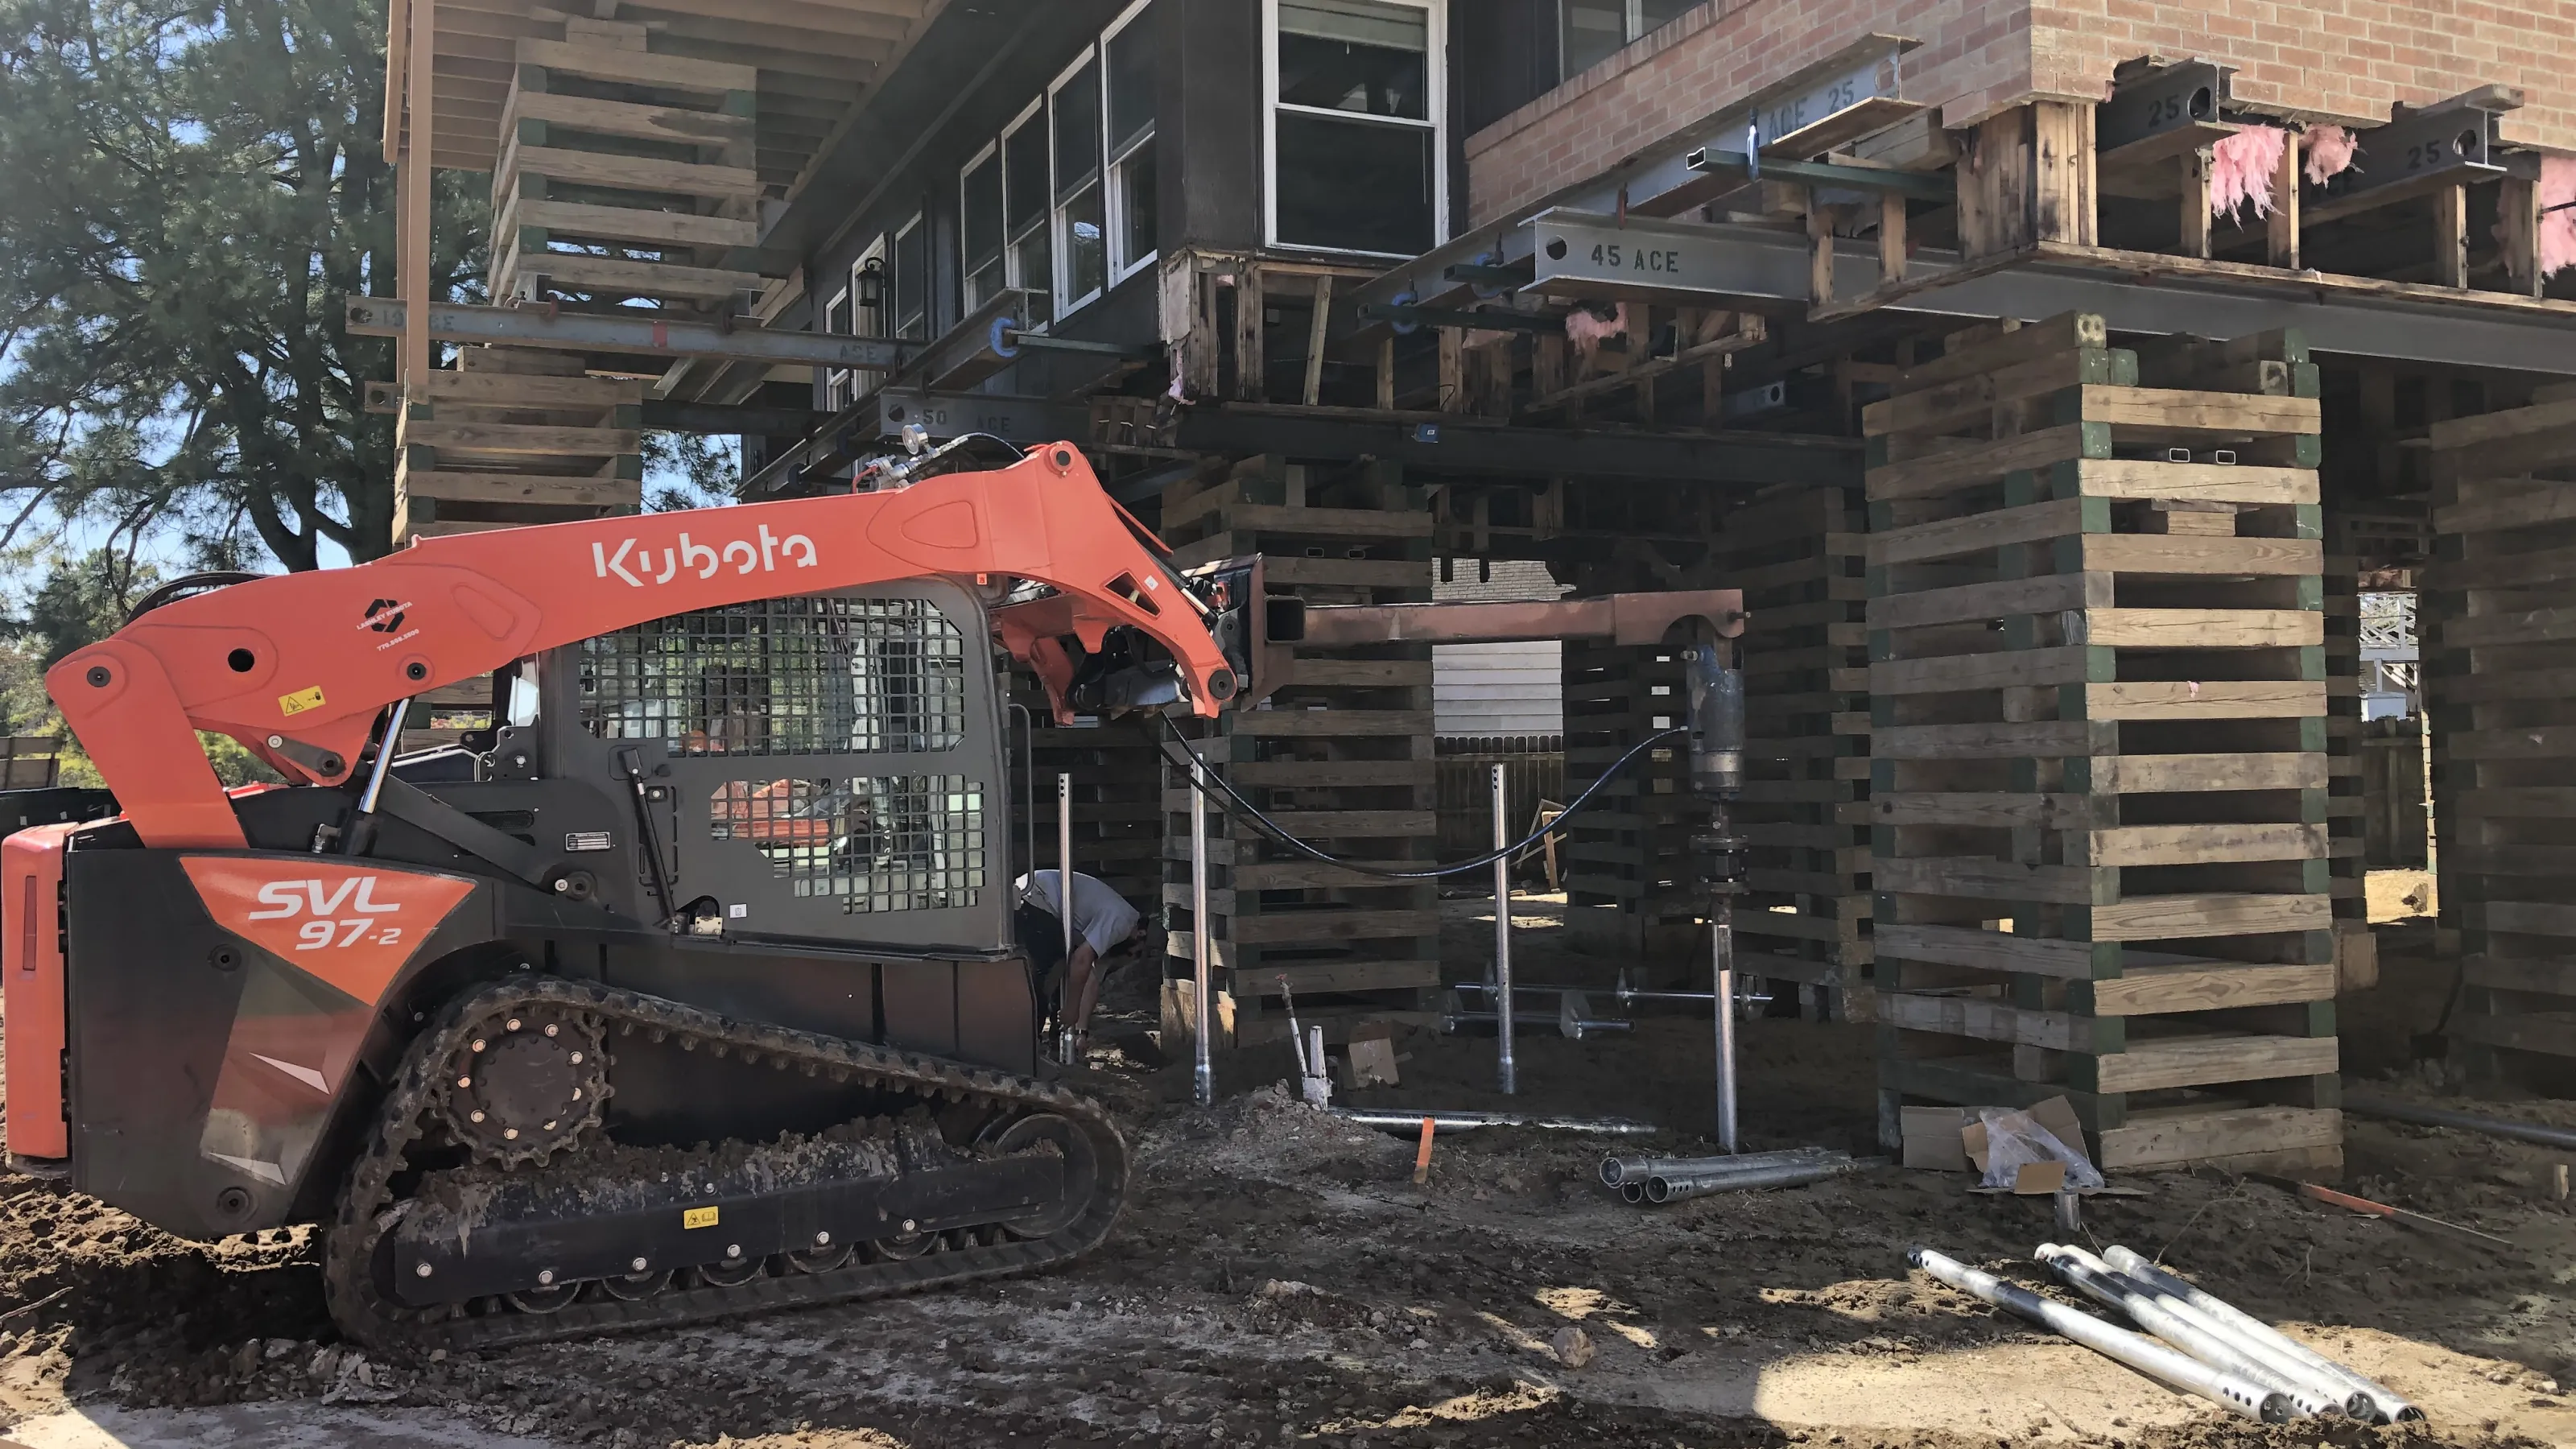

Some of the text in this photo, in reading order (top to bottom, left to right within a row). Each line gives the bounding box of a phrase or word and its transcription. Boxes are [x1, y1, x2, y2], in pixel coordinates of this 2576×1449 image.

[1768, 80, 1855, 142] ACE 25
[2148, 94, 2180, 128] 25
[2408, 138, 2441, 170] 25
[1591, 244, 1679, 272] 45 ACE
[839, 344, 877, 363] ACE
[923, 409, 1011, 432] 50 ACE
[592, 523, 818, 588] Kubota
[249, 877, 400, 919] SVL
[295, 918, 402, 950] 97-2
